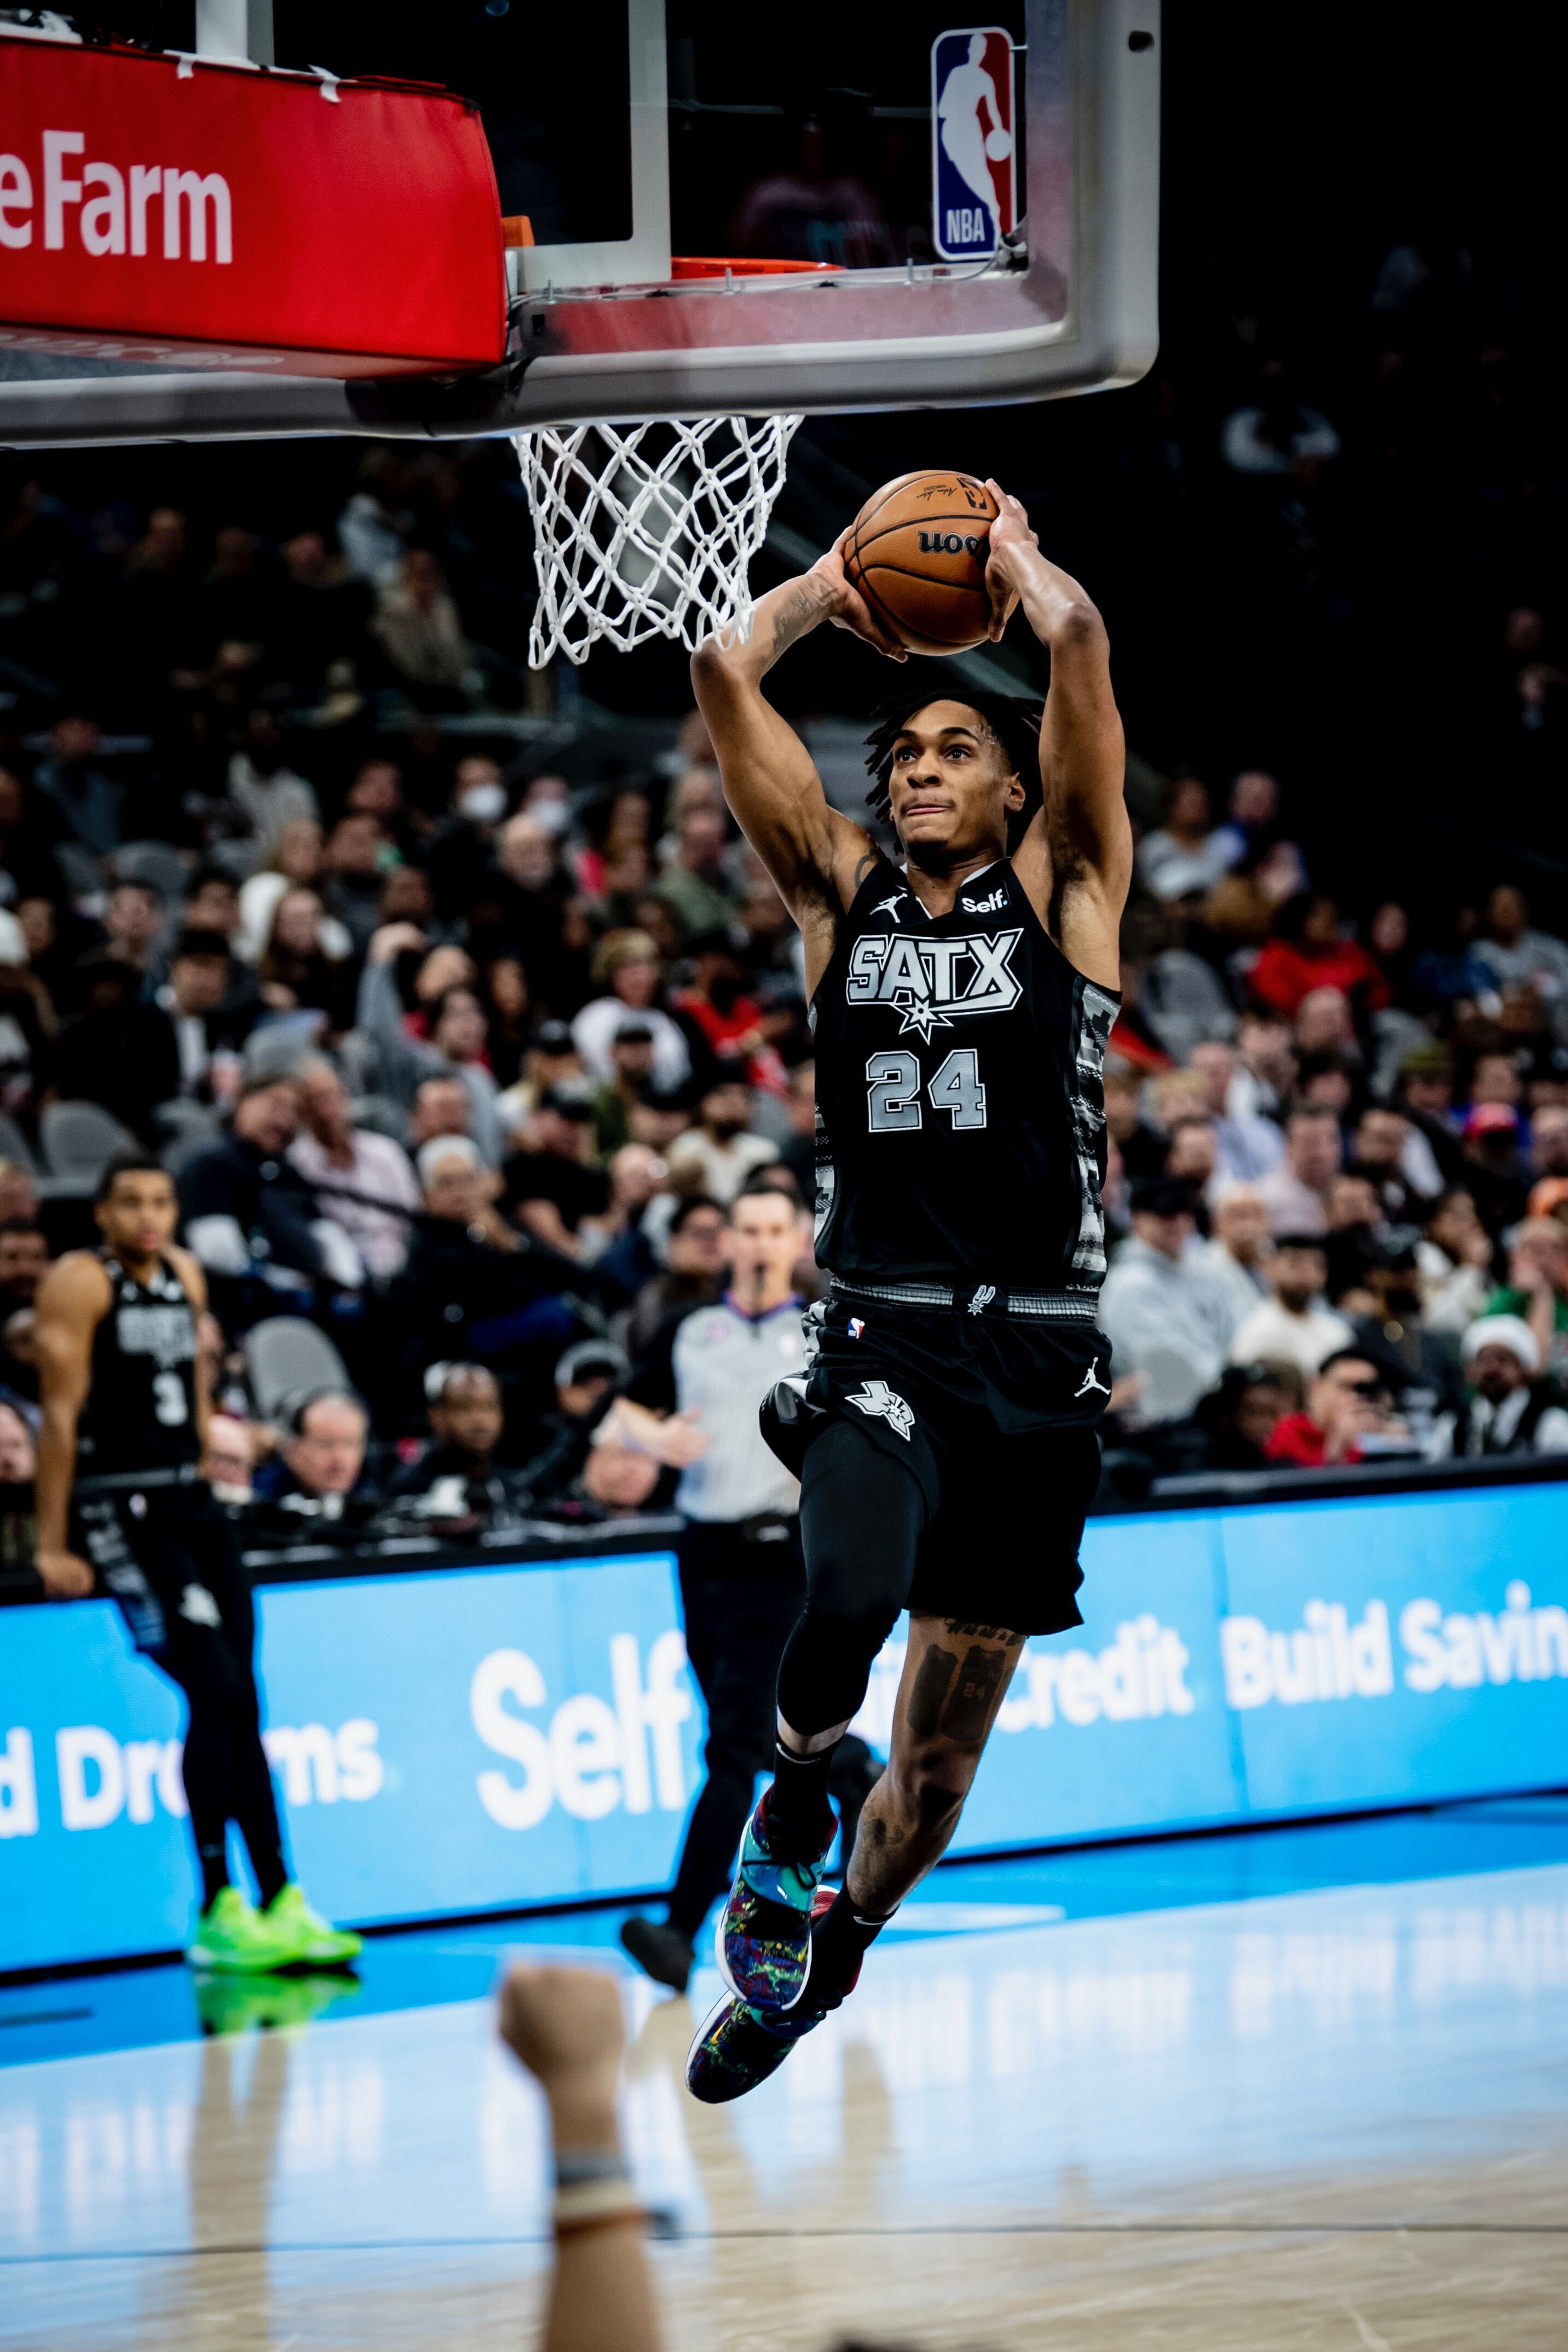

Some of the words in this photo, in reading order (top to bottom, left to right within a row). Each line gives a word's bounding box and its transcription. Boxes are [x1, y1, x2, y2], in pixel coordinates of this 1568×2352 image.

[946, 208, 985, 244] NBA
[846, 927, 1024, 1019] SATX
[866, 1048, 987, 1132] 24
[1220, 1597, 1394, 1709] Build
